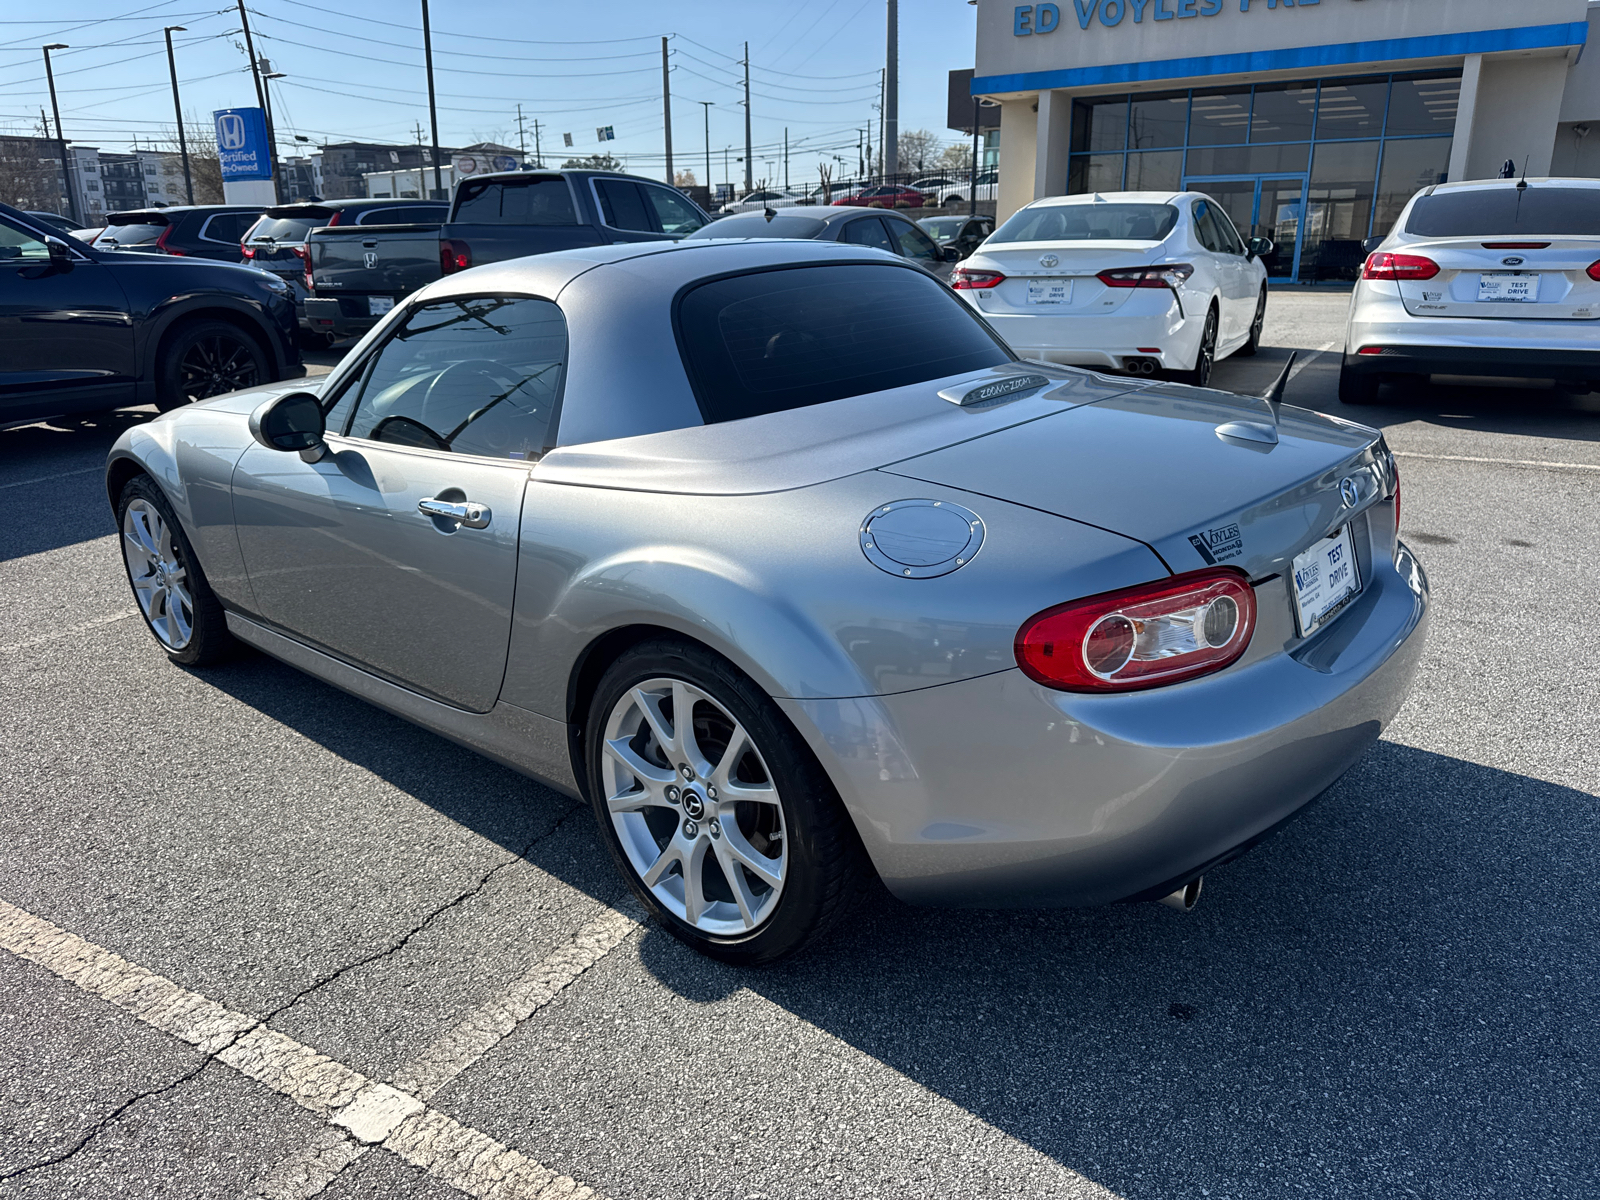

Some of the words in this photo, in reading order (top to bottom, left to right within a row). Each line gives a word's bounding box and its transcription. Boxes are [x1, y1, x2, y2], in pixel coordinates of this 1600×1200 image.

[1014, 4, 1060, 36] ED
[1073, 0, 1223, 30] VOYLES
[219, 150, 257, 162] Certified
[980, 377, 1031, 399] ZOOM-ZOOM
[1199, 525, 1239, 551] VOYLES
[1212, 543, 1236, 556] HONDA
[1327, 543, 1343, 567] TEST
[1328, 562, 1349, 589] DRIVE
